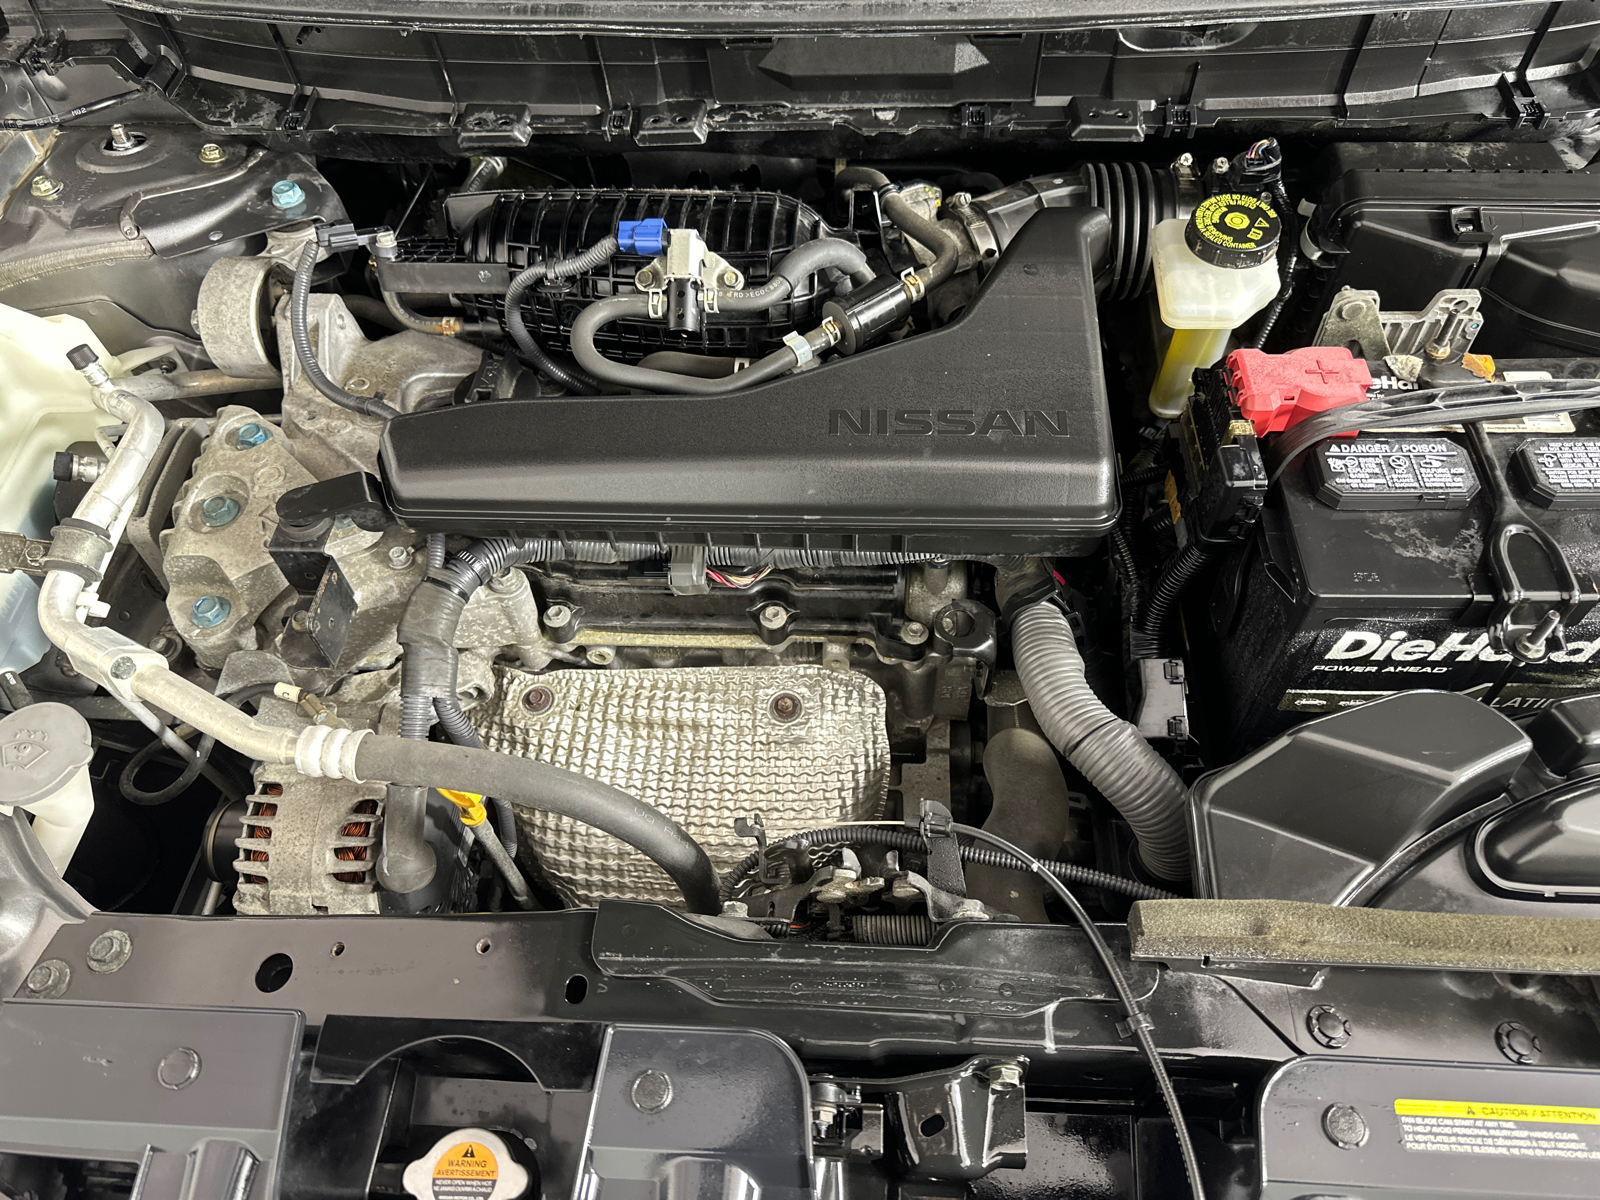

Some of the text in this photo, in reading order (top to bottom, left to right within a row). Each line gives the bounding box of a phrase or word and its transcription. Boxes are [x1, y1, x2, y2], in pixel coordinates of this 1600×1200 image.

[829, 409, 1070, 438] NISSAN
[1341, 444, 1447, 453] DANGER / POISON
[1312, 664, 1451, 674] POWER AHEAD
[1482, 1106, 1528, 1117] CAUTION
[1540, 1111, 1597, 1121] ATTENTION
[447, 1159, 487, 1168] WARNING
[436, 1169, 496, 1178] AVERTISSEMENT
